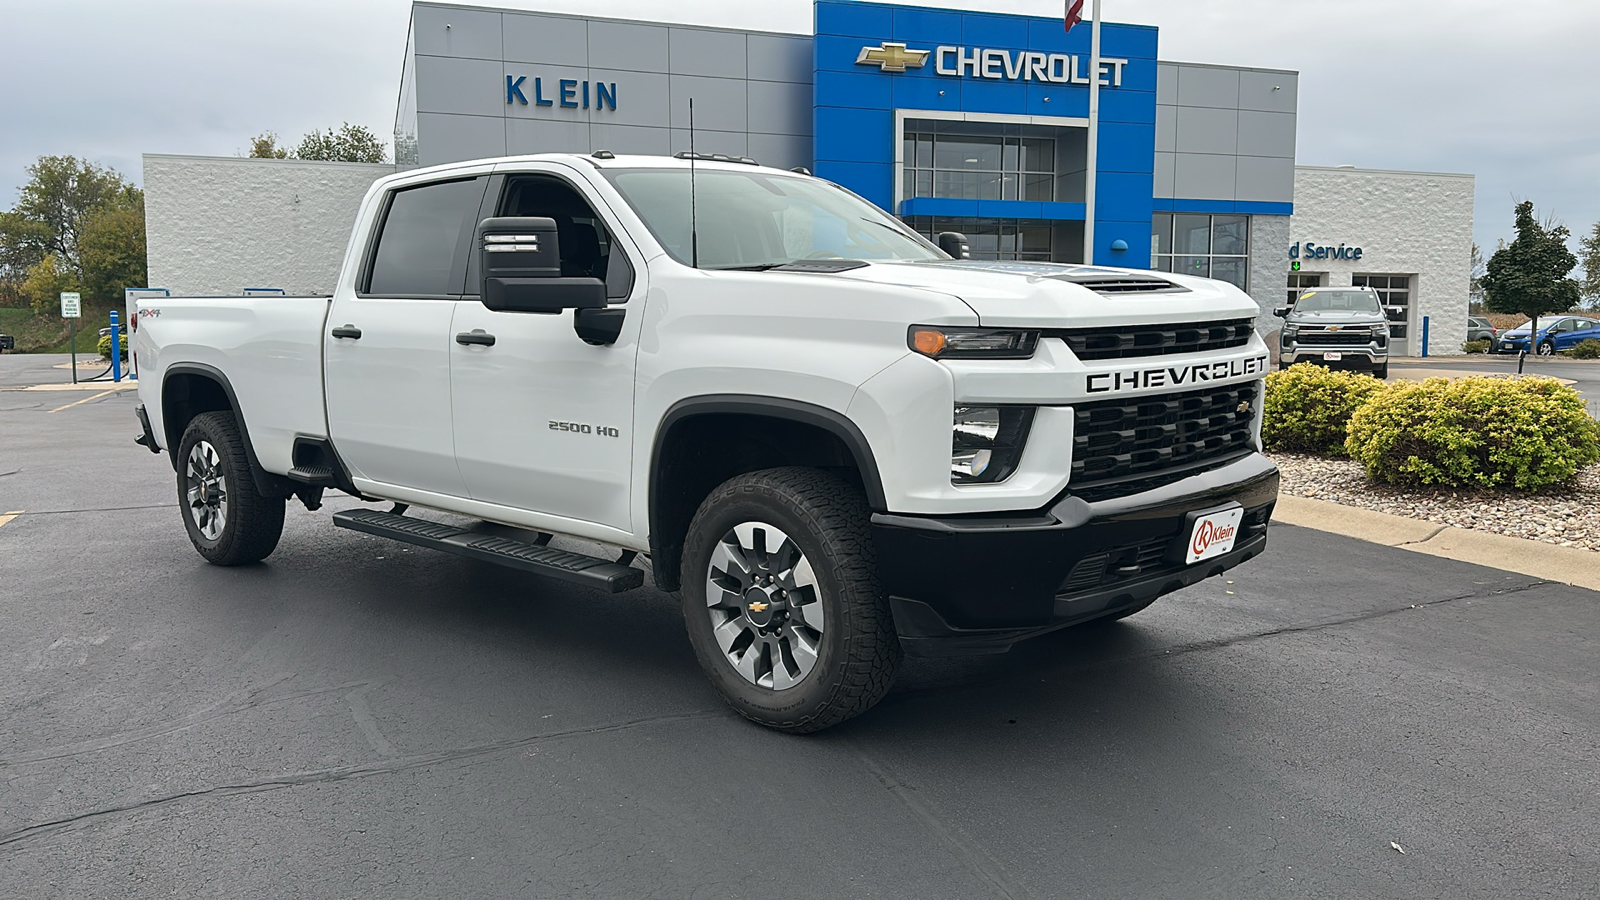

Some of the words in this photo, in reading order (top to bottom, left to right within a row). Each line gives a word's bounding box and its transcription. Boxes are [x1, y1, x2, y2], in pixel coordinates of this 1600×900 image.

[936, 45, 1128, 86] CHEVROLET
[506, 75, 617, 111] KLEIN
[1305, 242, 1363, 260] Service
[1086, 356, 1267, 393] CHEVROLET
[548, 420, 592, 434] 2500
[596, 426, 619, 438] HD
[1212, 524, 1234, 541] Klein
